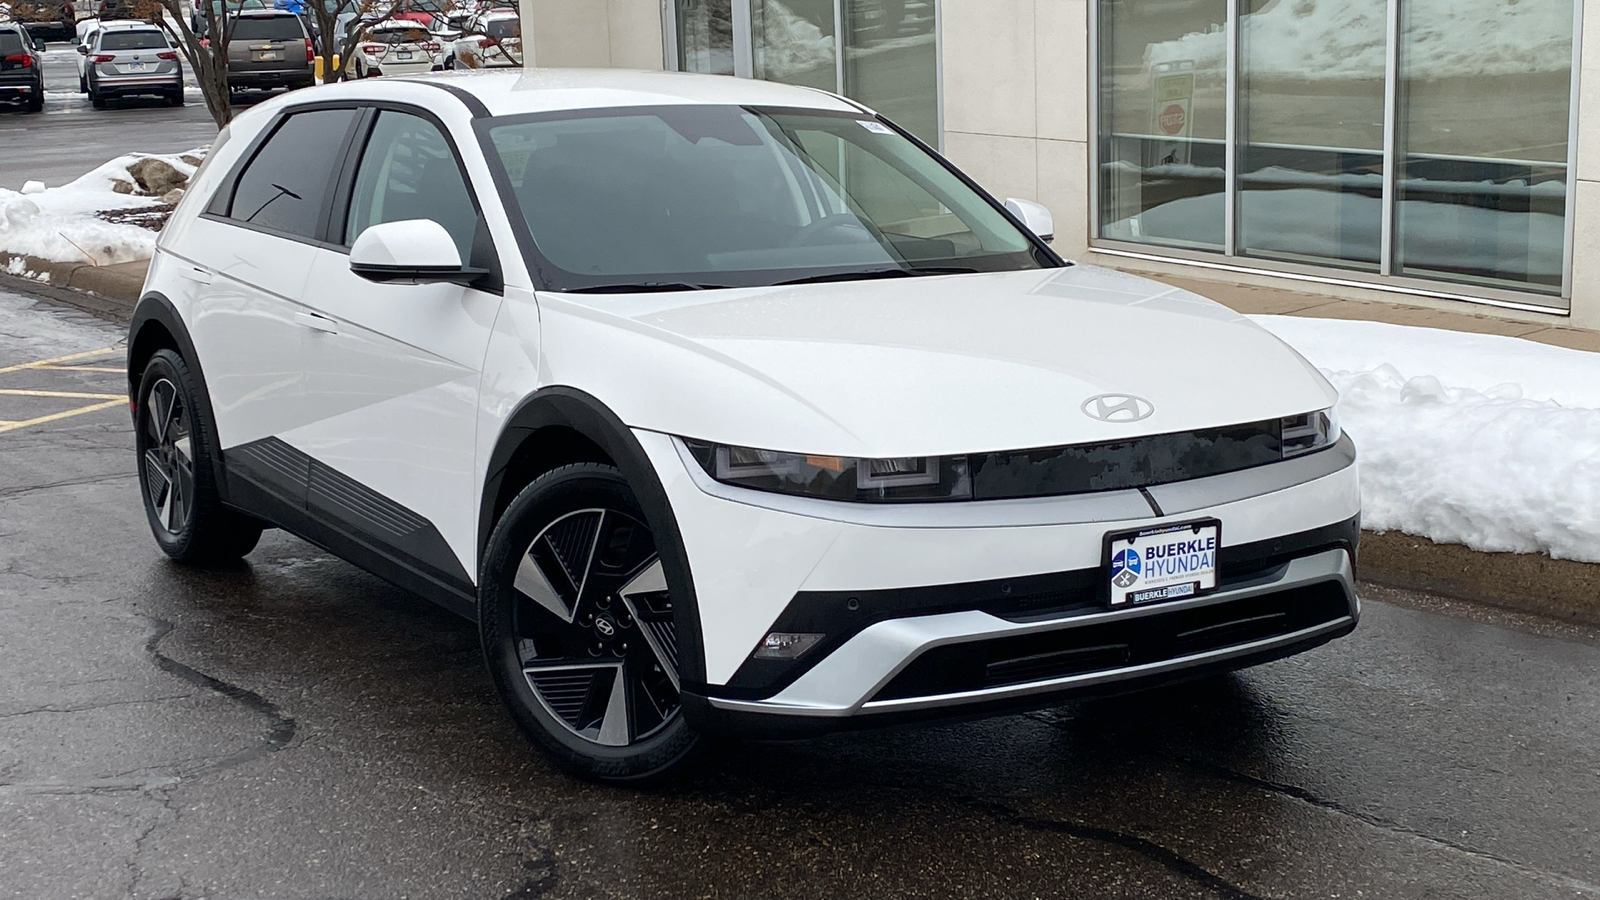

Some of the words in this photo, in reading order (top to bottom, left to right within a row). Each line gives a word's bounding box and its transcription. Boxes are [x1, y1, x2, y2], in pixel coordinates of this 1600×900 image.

[1146, 537, 1215, 560] BUERKLE
[1145, 551, 1214, 578] HYUNDAI
[1135, 589, 1168, 602] BUERKLE
[1168, 585, 1192, 596] HYUNDAI
